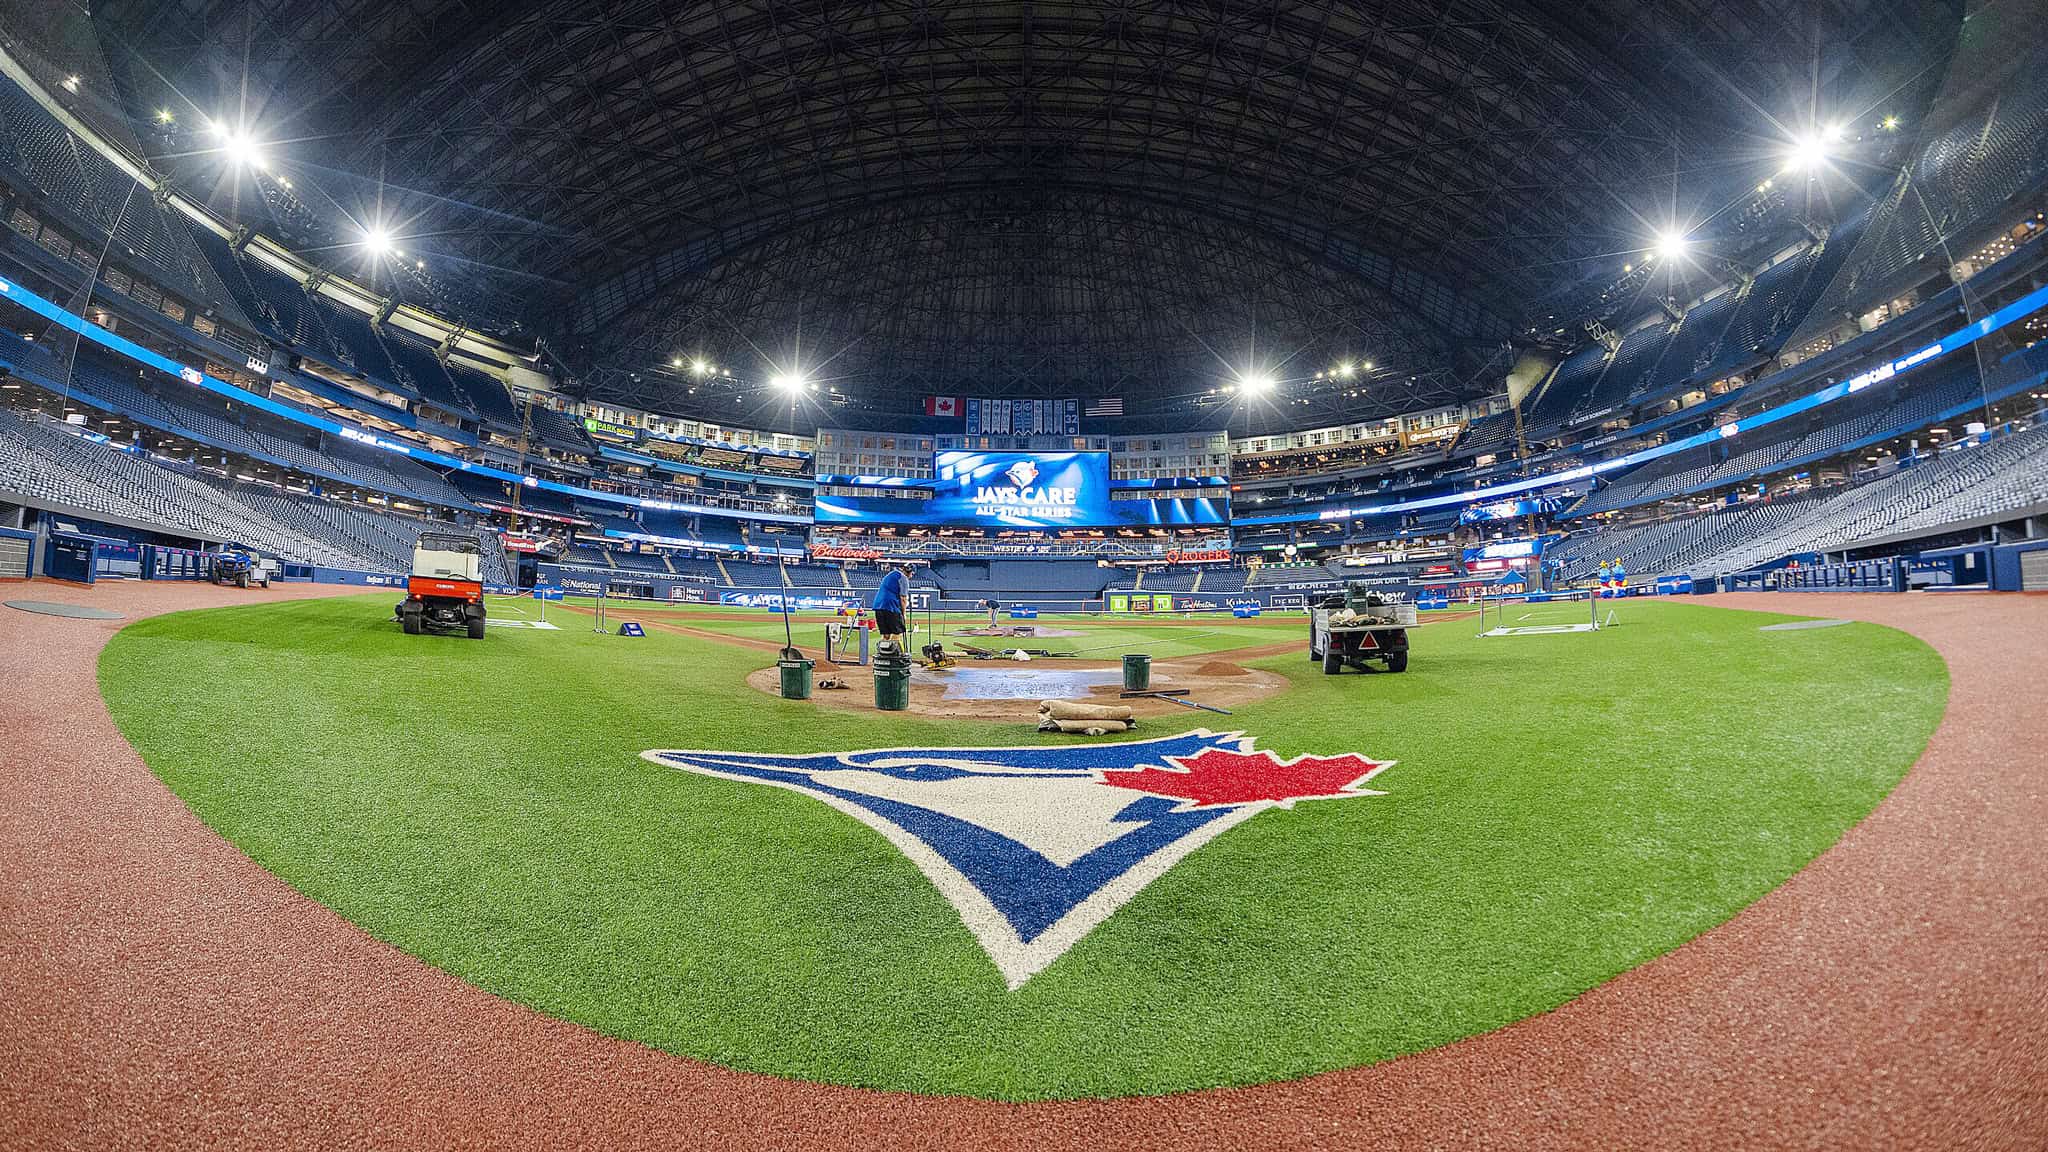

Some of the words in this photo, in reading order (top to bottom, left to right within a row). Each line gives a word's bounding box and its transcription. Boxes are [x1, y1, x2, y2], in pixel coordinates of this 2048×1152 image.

[1065, 415, 1078, 423] 32
[598, 422, 617, 432] PARK
[971, 487, 1019, 504] JAYS
[1020, 487, 1076, 504] CARE
[975, 506, 1029, 516] ALL-STAR
[1031, 507, 1073, 518] SERIES
[809, 543, 884, 558] Budweiser
[993, 545, 1026, 553] WESTJET
[1181, 550, 1231, 561] ROGERS
[1391, 553, 1407, 562] BET
[570, 579, 602, 590] National
[1114, 599, 1125, 609] TD
[1192, 600, 1218, 608] Hortons
